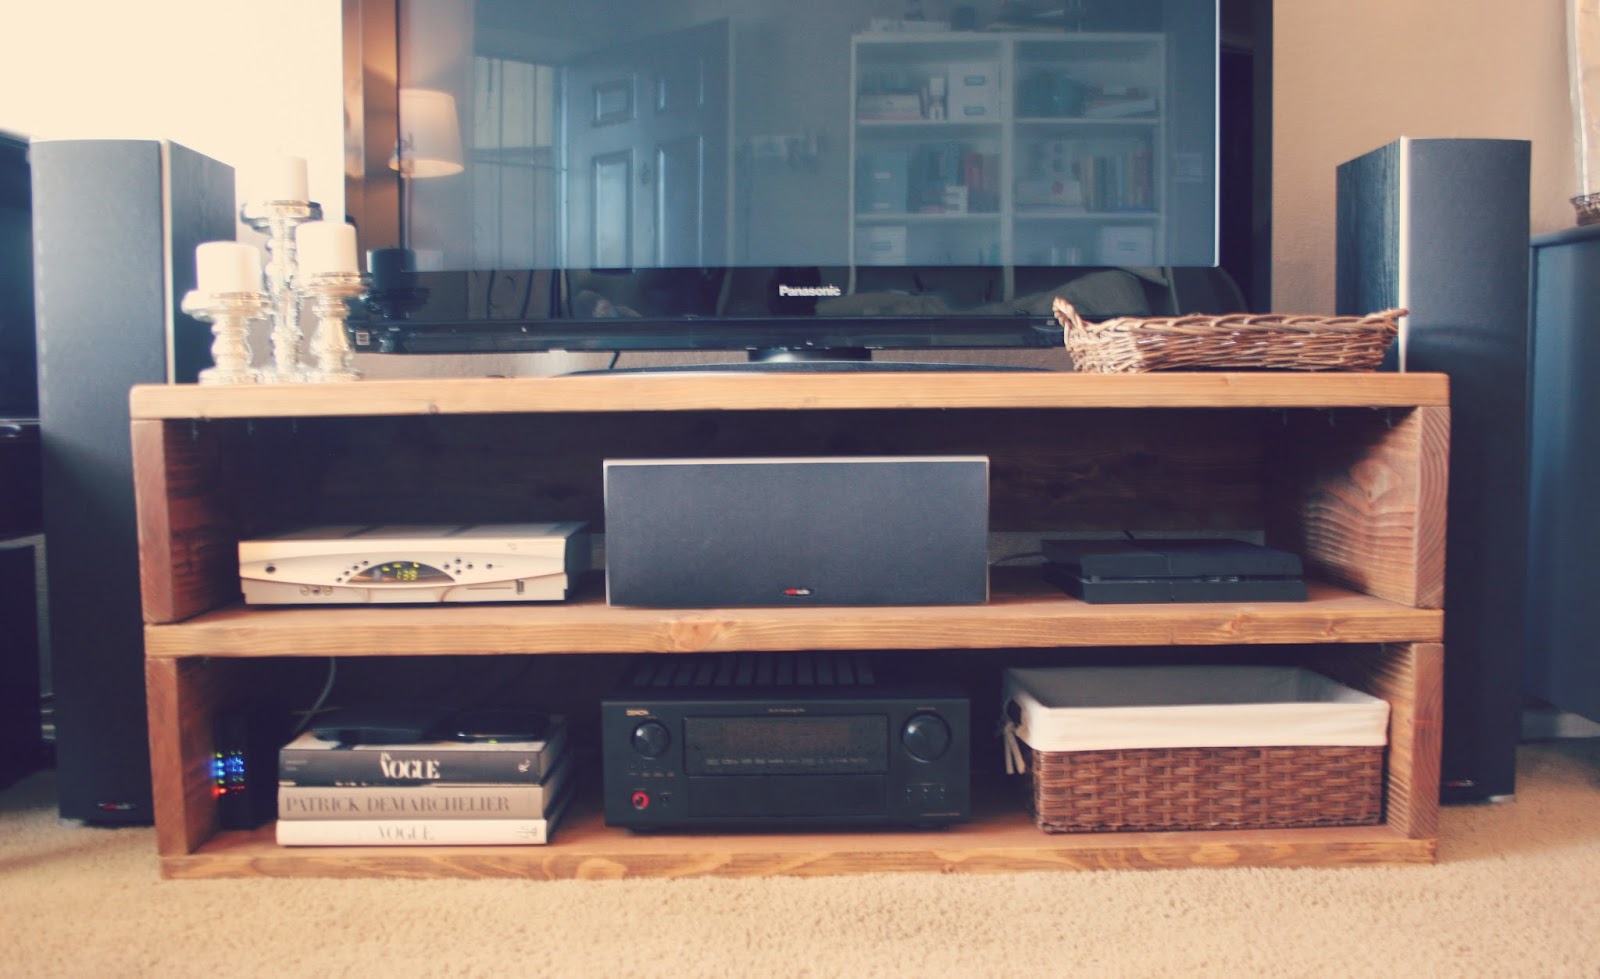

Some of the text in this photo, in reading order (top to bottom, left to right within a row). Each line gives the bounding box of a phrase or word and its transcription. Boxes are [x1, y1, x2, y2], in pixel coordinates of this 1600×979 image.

[779, 284, 841, 296] Panasonic
[380, 759, 440, 779] VOGUE
[286, 796, 510, 812] PATRICK DEMARCHELIER
[378, 825, 435, 841] VOGUE
